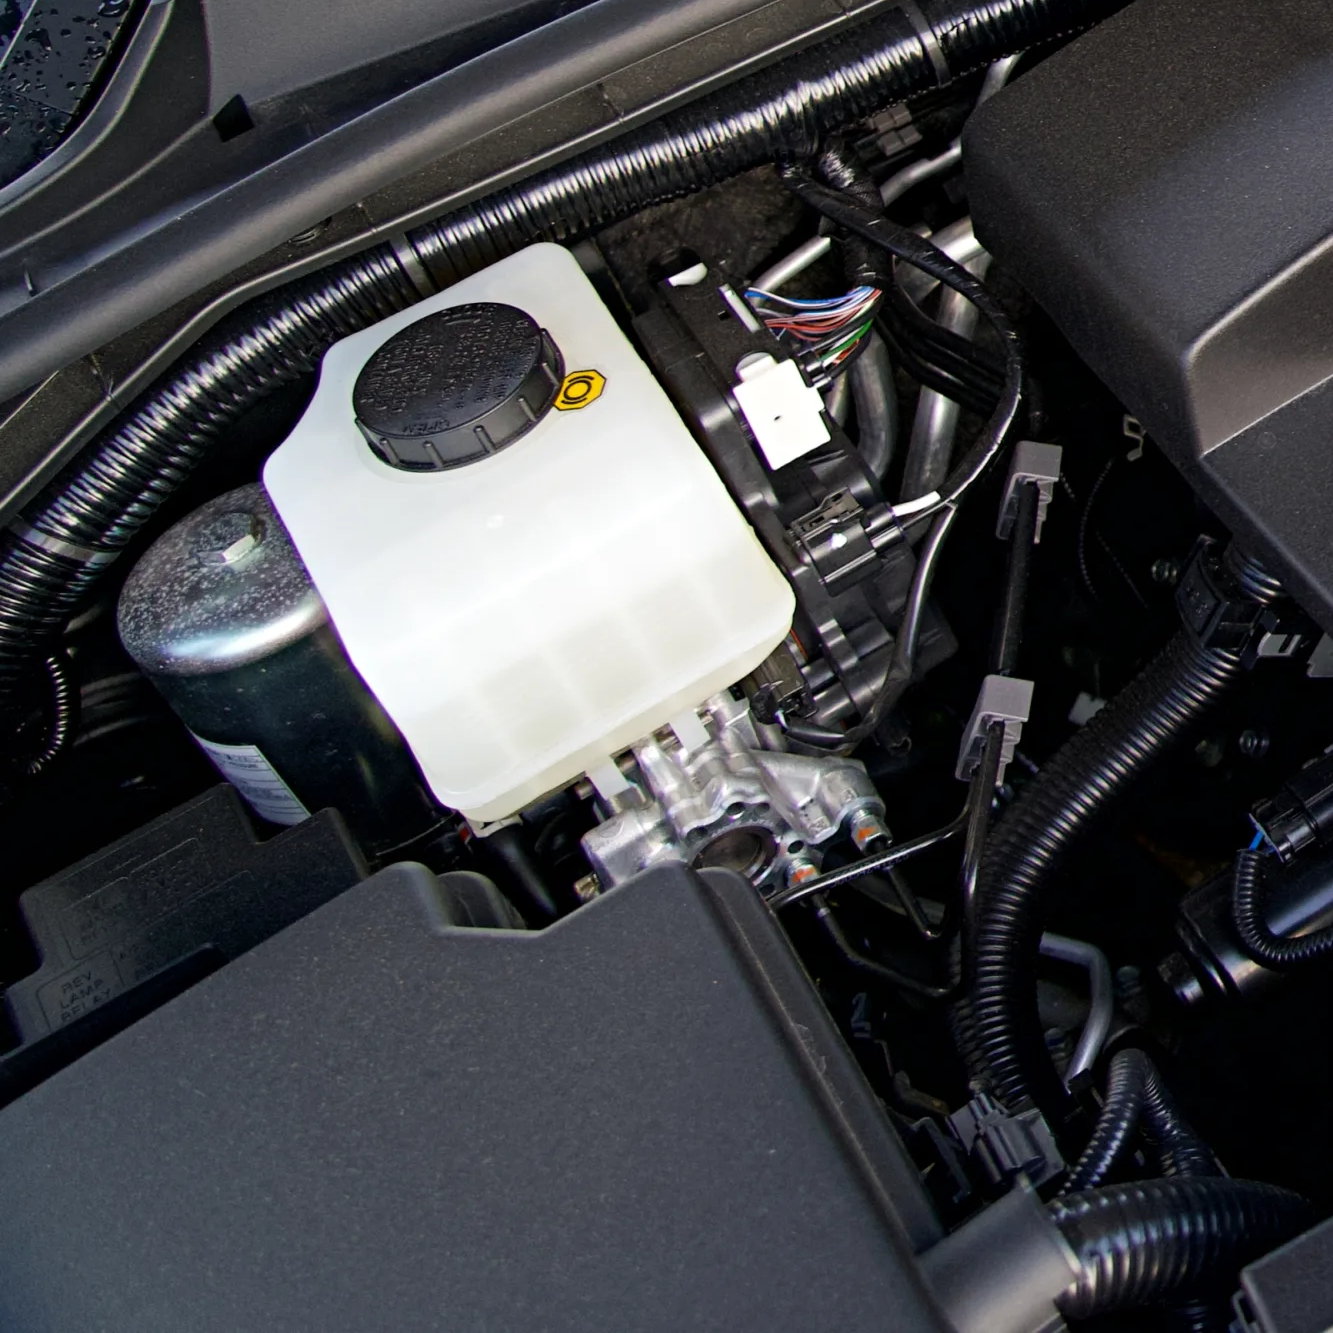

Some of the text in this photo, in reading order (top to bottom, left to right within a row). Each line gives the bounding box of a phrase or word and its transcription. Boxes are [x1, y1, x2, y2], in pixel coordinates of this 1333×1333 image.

[60, 979, 104, 1009] LAMP
[61, 970, 91, 994] REV
[61, 988, 111, 1021] RELAY
